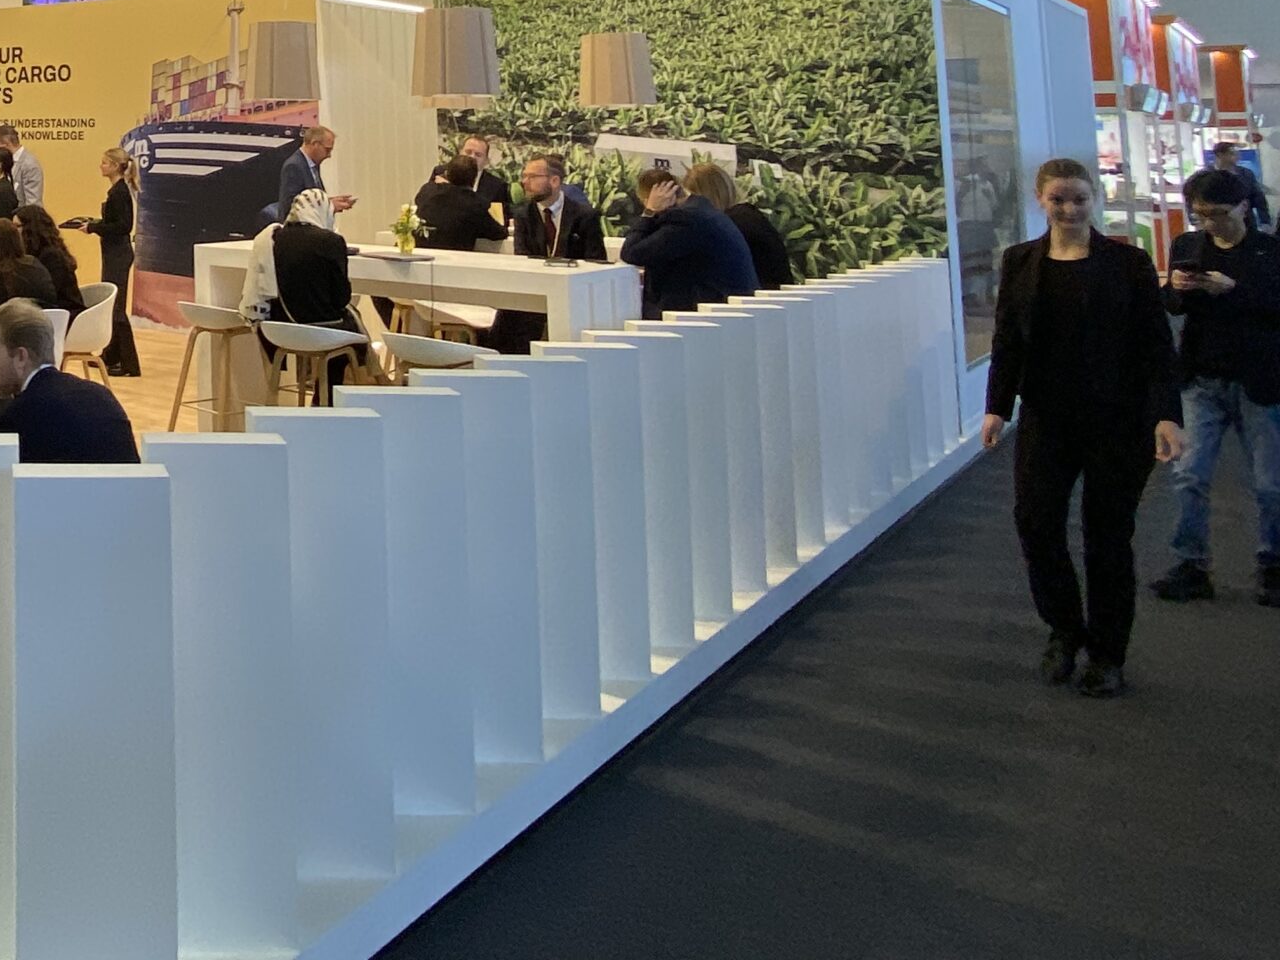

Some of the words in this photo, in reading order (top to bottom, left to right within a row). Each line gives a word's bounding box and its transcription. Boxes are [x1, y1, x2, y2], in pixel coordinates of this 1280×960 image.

[5, 64, 72, 83] CARGO
[11, 118, 95, 128] UNDERSTANDING
[21, 131, 84, 140] KNOWLEDGE
